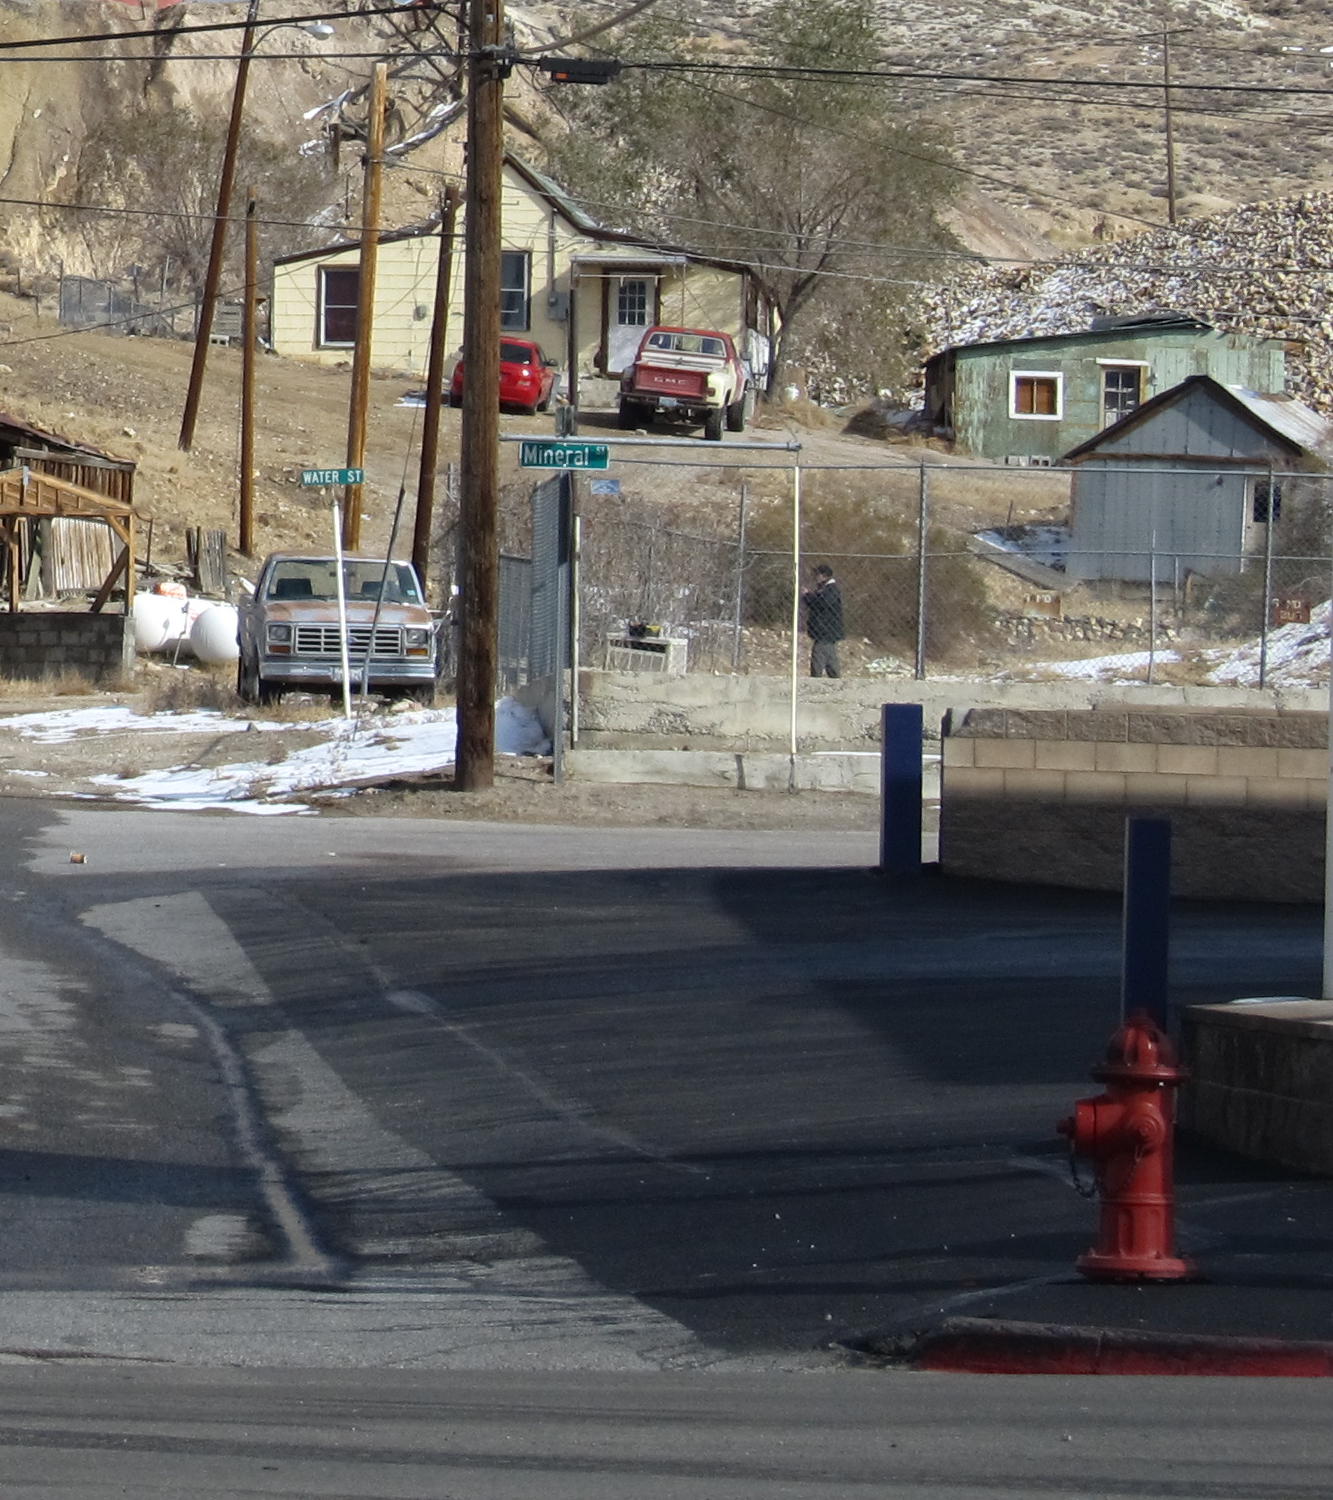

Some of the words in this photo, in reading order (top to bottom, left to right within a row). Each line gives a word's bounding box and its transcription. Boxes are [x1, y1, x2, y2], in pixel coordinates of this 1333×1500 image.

[523, 444, 589, 467] Mineral
[302, 470, 340, 484] WATER
[347, 469, 362, 483] ST
